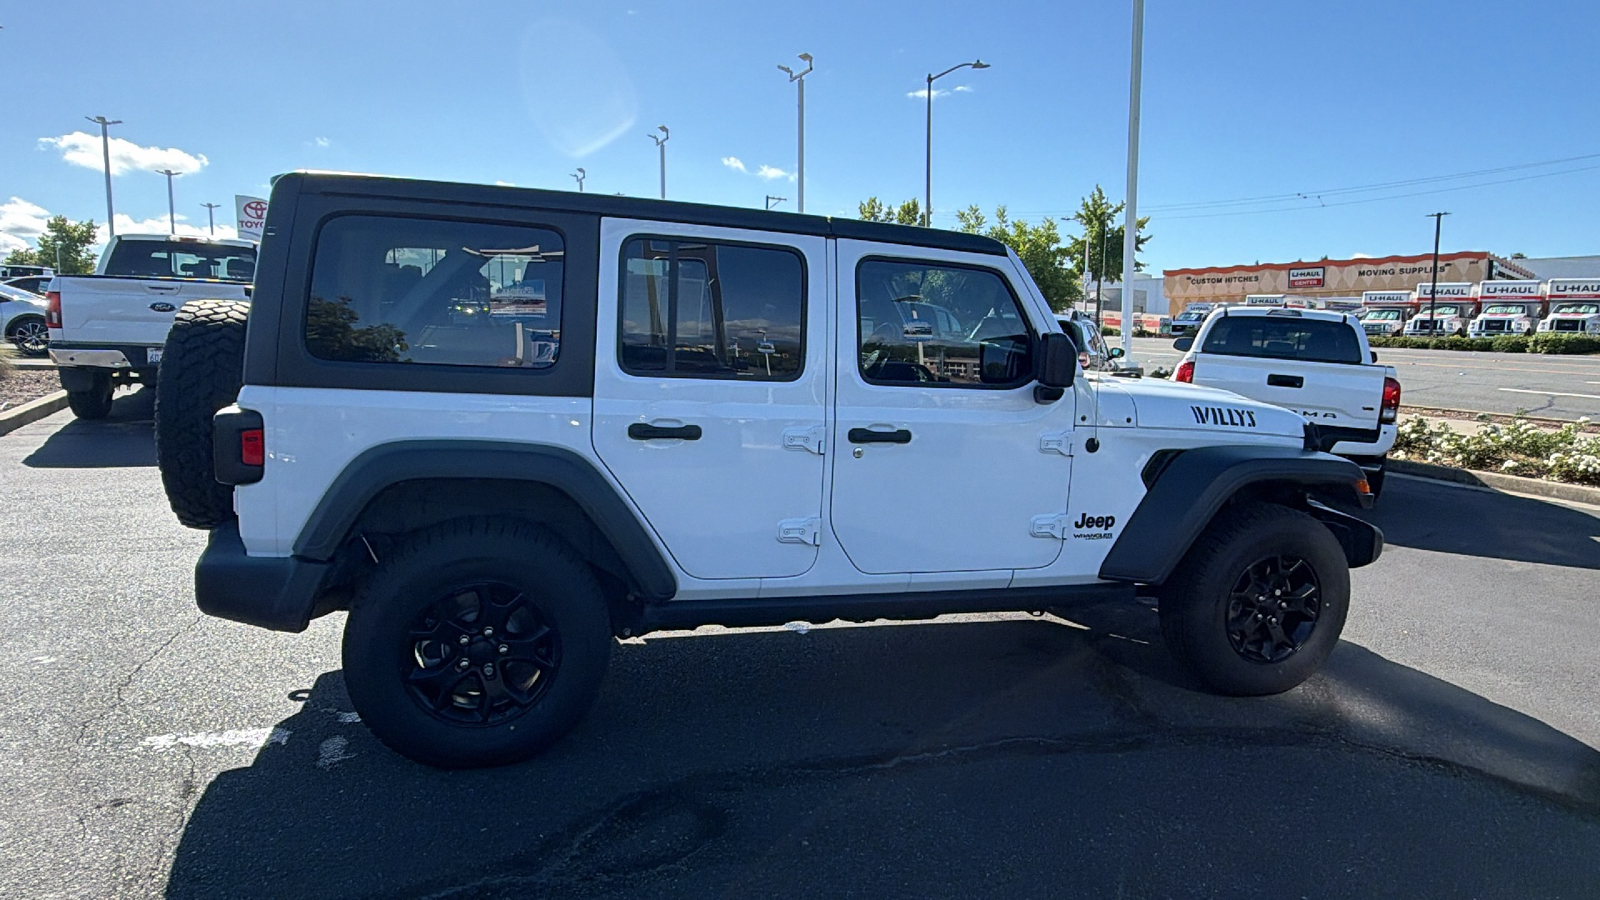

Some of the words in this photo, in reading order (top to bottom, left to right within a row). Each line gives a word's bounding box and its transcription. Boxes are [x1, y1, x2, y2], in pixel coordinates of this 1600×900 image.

[1357, 268, 1396, 277] MOVING
[1398, 265, 1446, 275] SUPPLIS
[1190, 277, 1223, 285] CUSTOM
[1224, 275, 1259, 284] HITCHES
[1486, 286, 1535, 294] U-HAUL
[1190, 405, 1257, 428] WILLYS
[1074, 512, 1116, 531] Jeep
